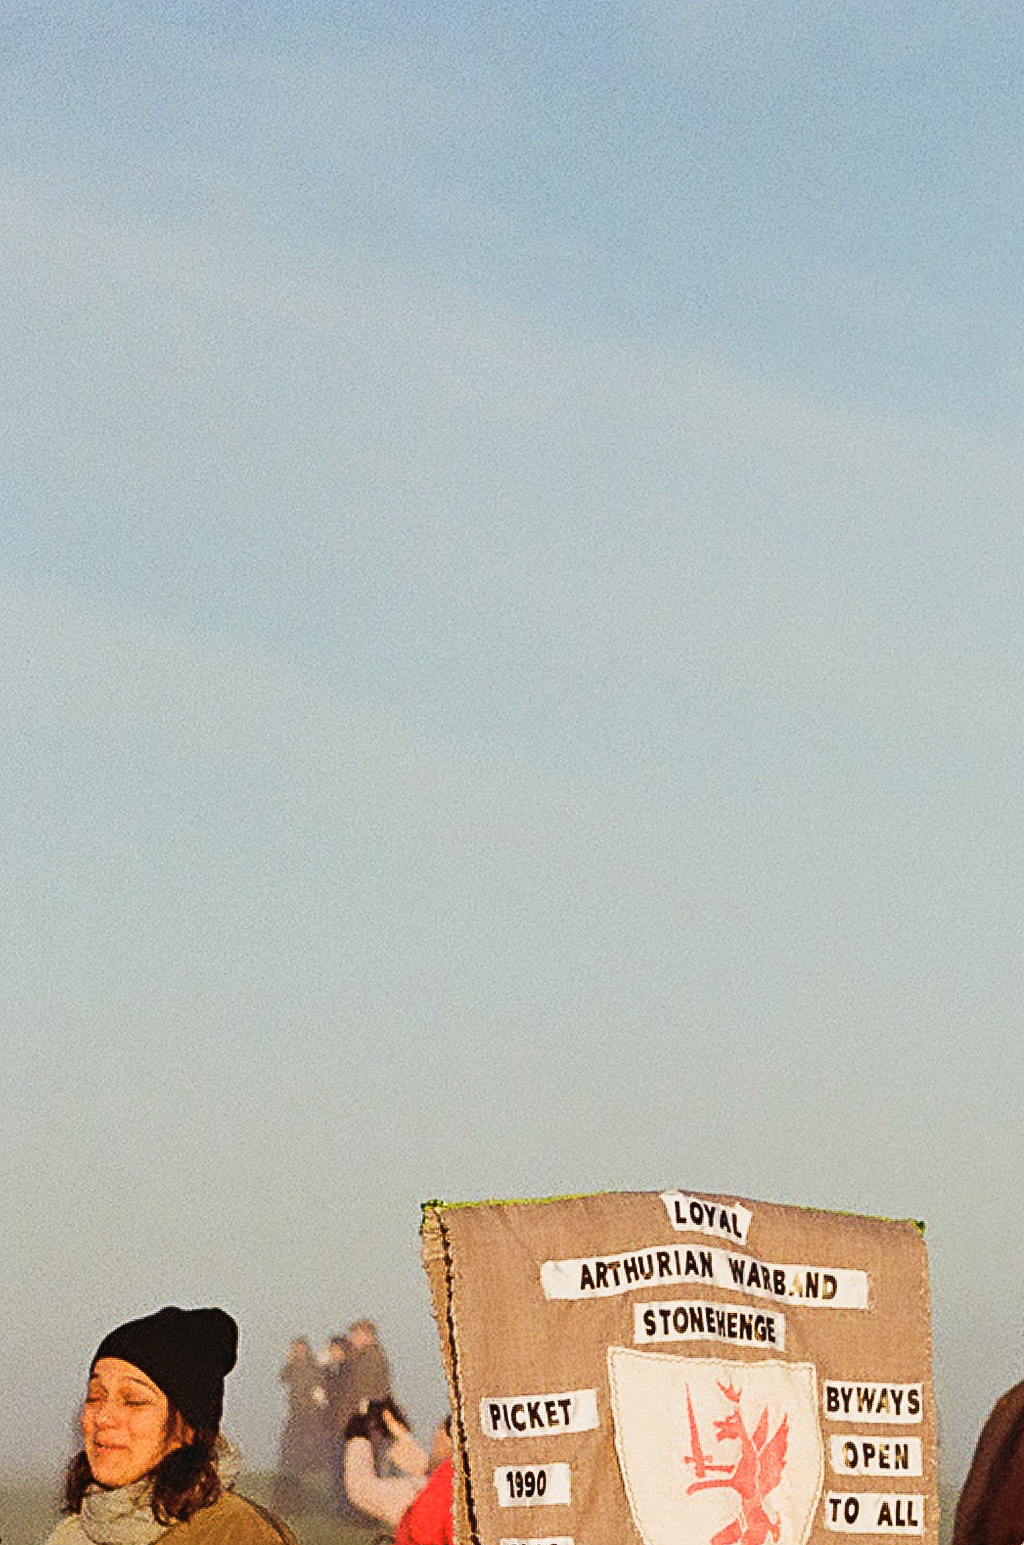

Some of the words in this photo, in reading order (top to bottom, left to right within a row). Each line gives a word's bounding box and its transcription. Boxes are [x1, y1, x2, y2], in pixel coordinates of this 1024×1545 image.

[673, 1200, 742, 1238] LOYAL
[580, 1250, 713, 1290] ARTHURIAN
[728, 1257, 838, 1300] WARBAND
[643, 1306, 776, 1343] STONEHENGE
[489, 1398, 571, 1432] PICKET
[826, 1386, 920, 1416] BYWAYS
[843, 1441, 909, 1469] OPEN
[506, 1469, 547, 1499] 1990
[829, 1496, 860, 1524] TO
[877, 1500, 918, 1527] ALL
